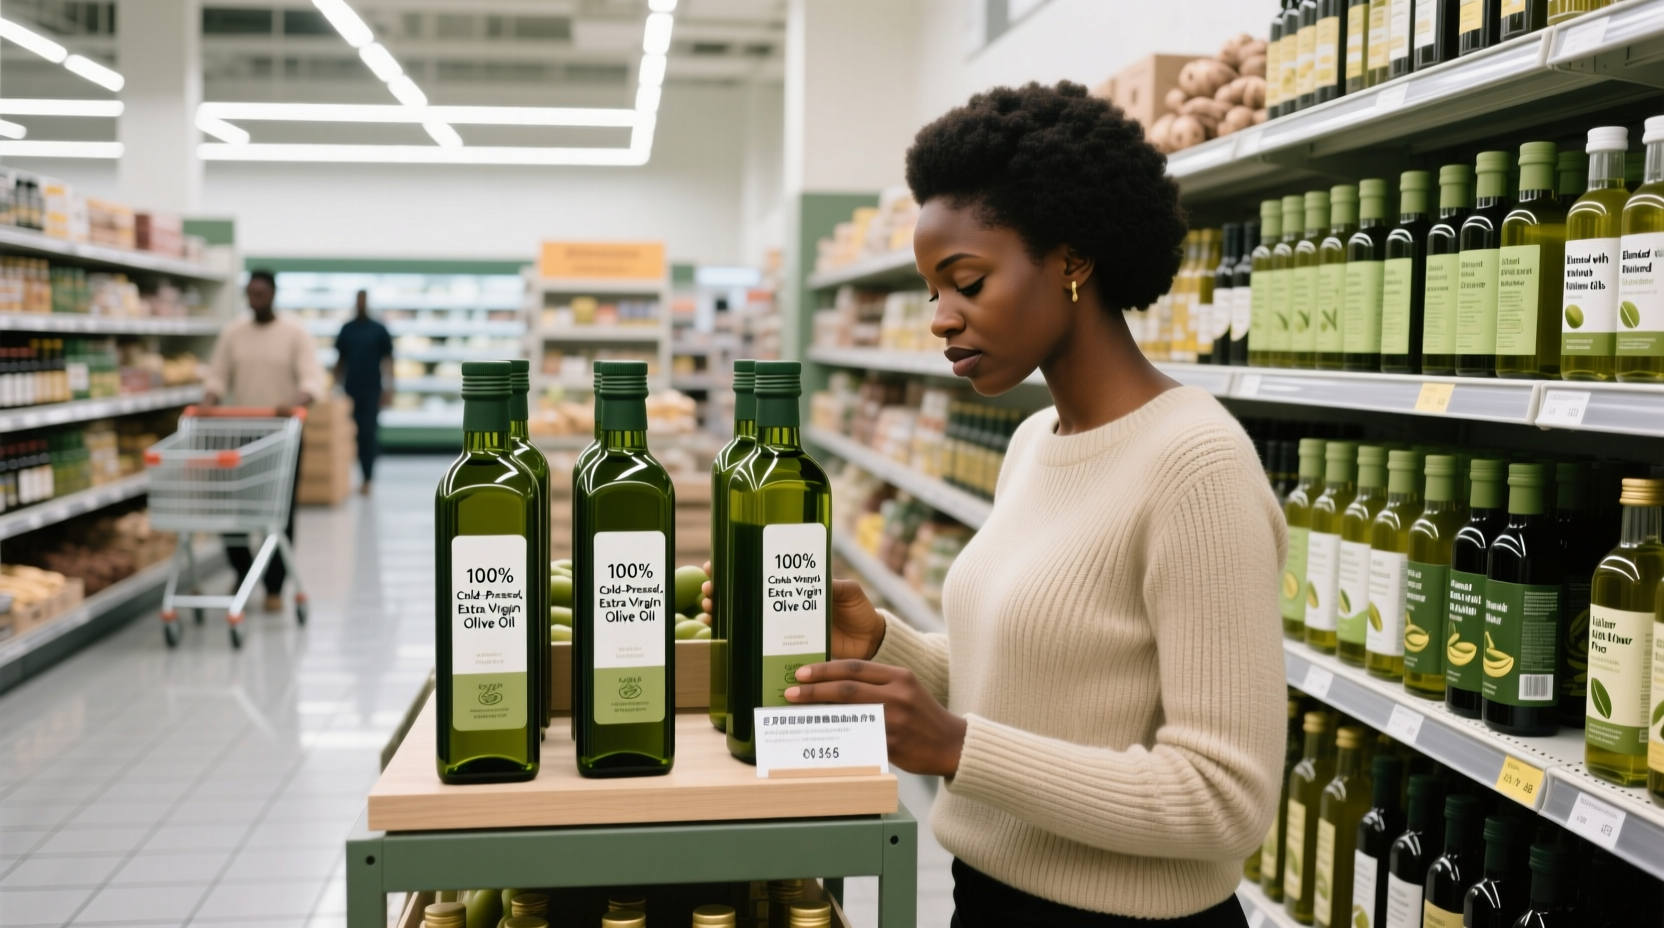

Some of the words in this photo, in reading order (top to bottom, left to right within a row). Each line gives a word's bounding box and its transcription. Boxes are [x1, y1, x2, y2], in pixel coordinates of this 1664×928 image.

[775, 553, 816, 569] 100%
[466, 567, 514, 583] 100%
[607, 563, 653, 579] 100%
[463, 616, 495, 629] Olive
[498, 616, 515, 628] Oil
[605, 610, 635, 622] Olive
